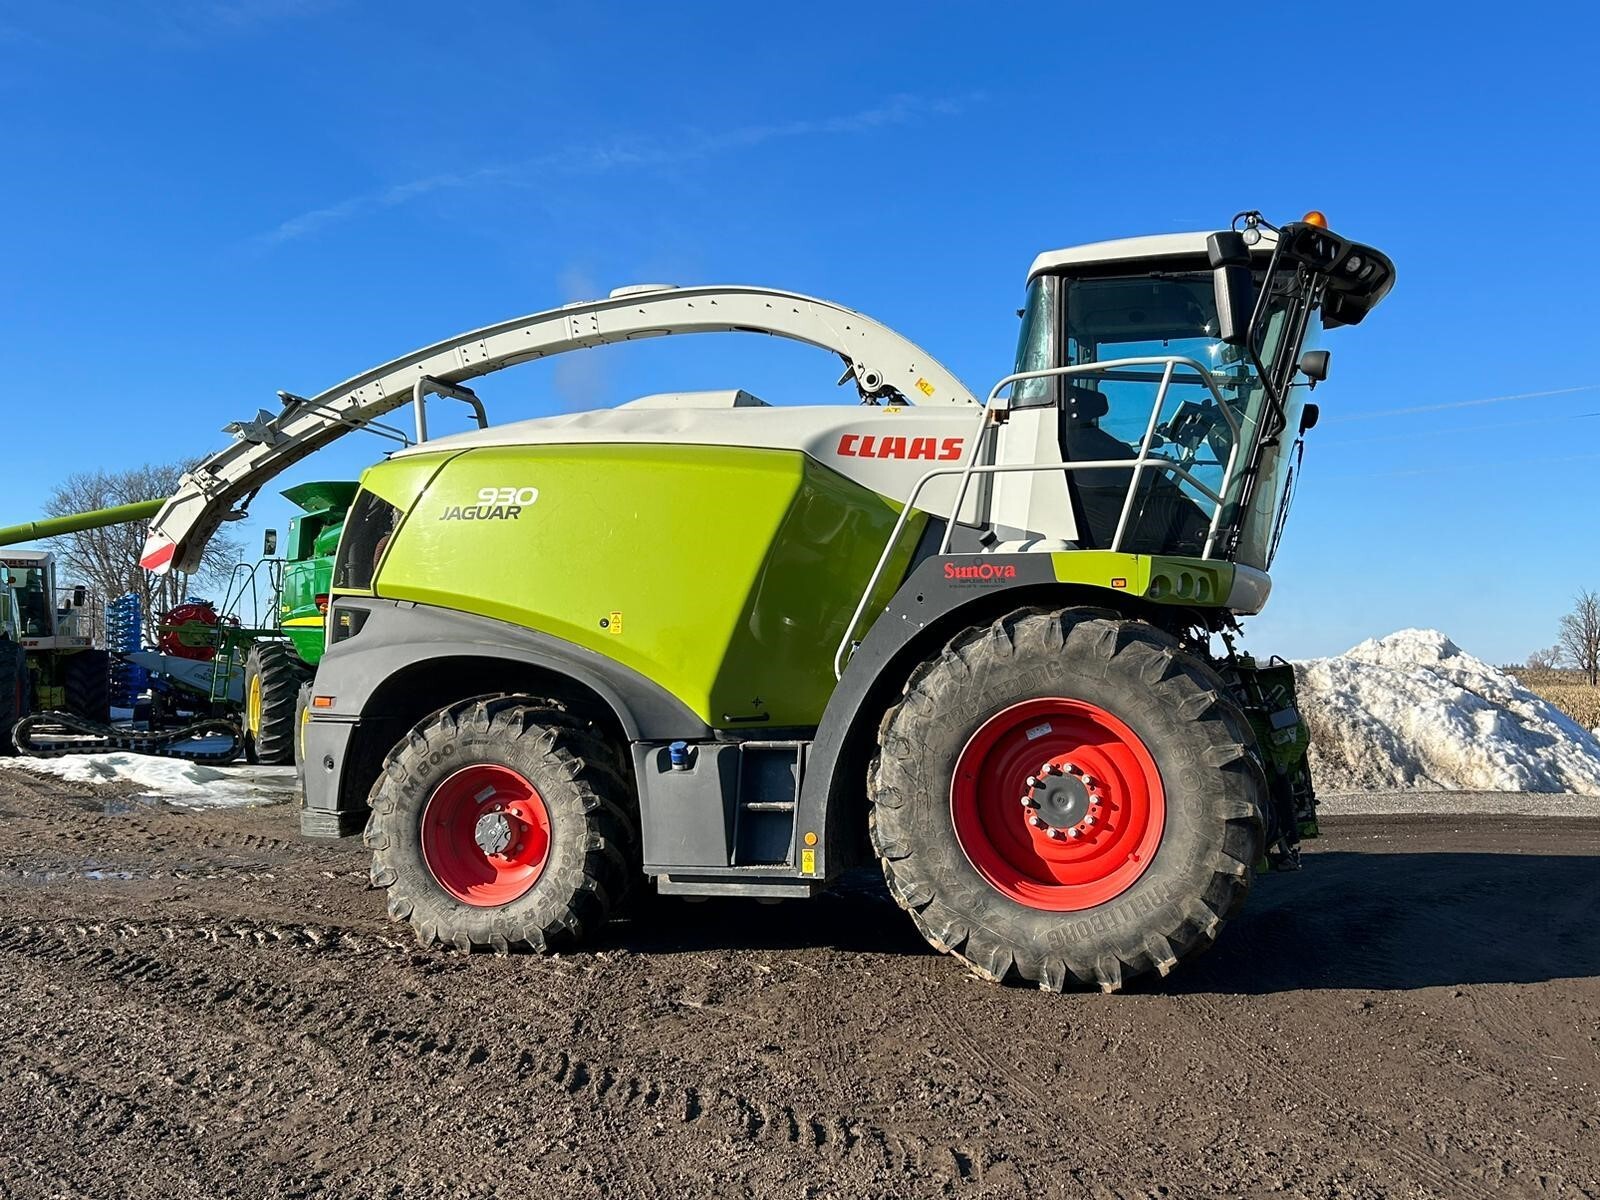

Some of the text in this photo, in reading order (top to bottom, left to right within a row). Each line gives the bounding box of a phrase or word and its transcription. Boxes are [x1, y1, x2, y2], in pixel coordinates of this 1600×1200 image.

[837, 434, 964, 460] CLAAS
[475, 487, 539, 506] 930
[439, 506, 522, 520] JAGUAR
[944, 562, 1016, 579] SunOva
[416, 743, 455, 777] 800
